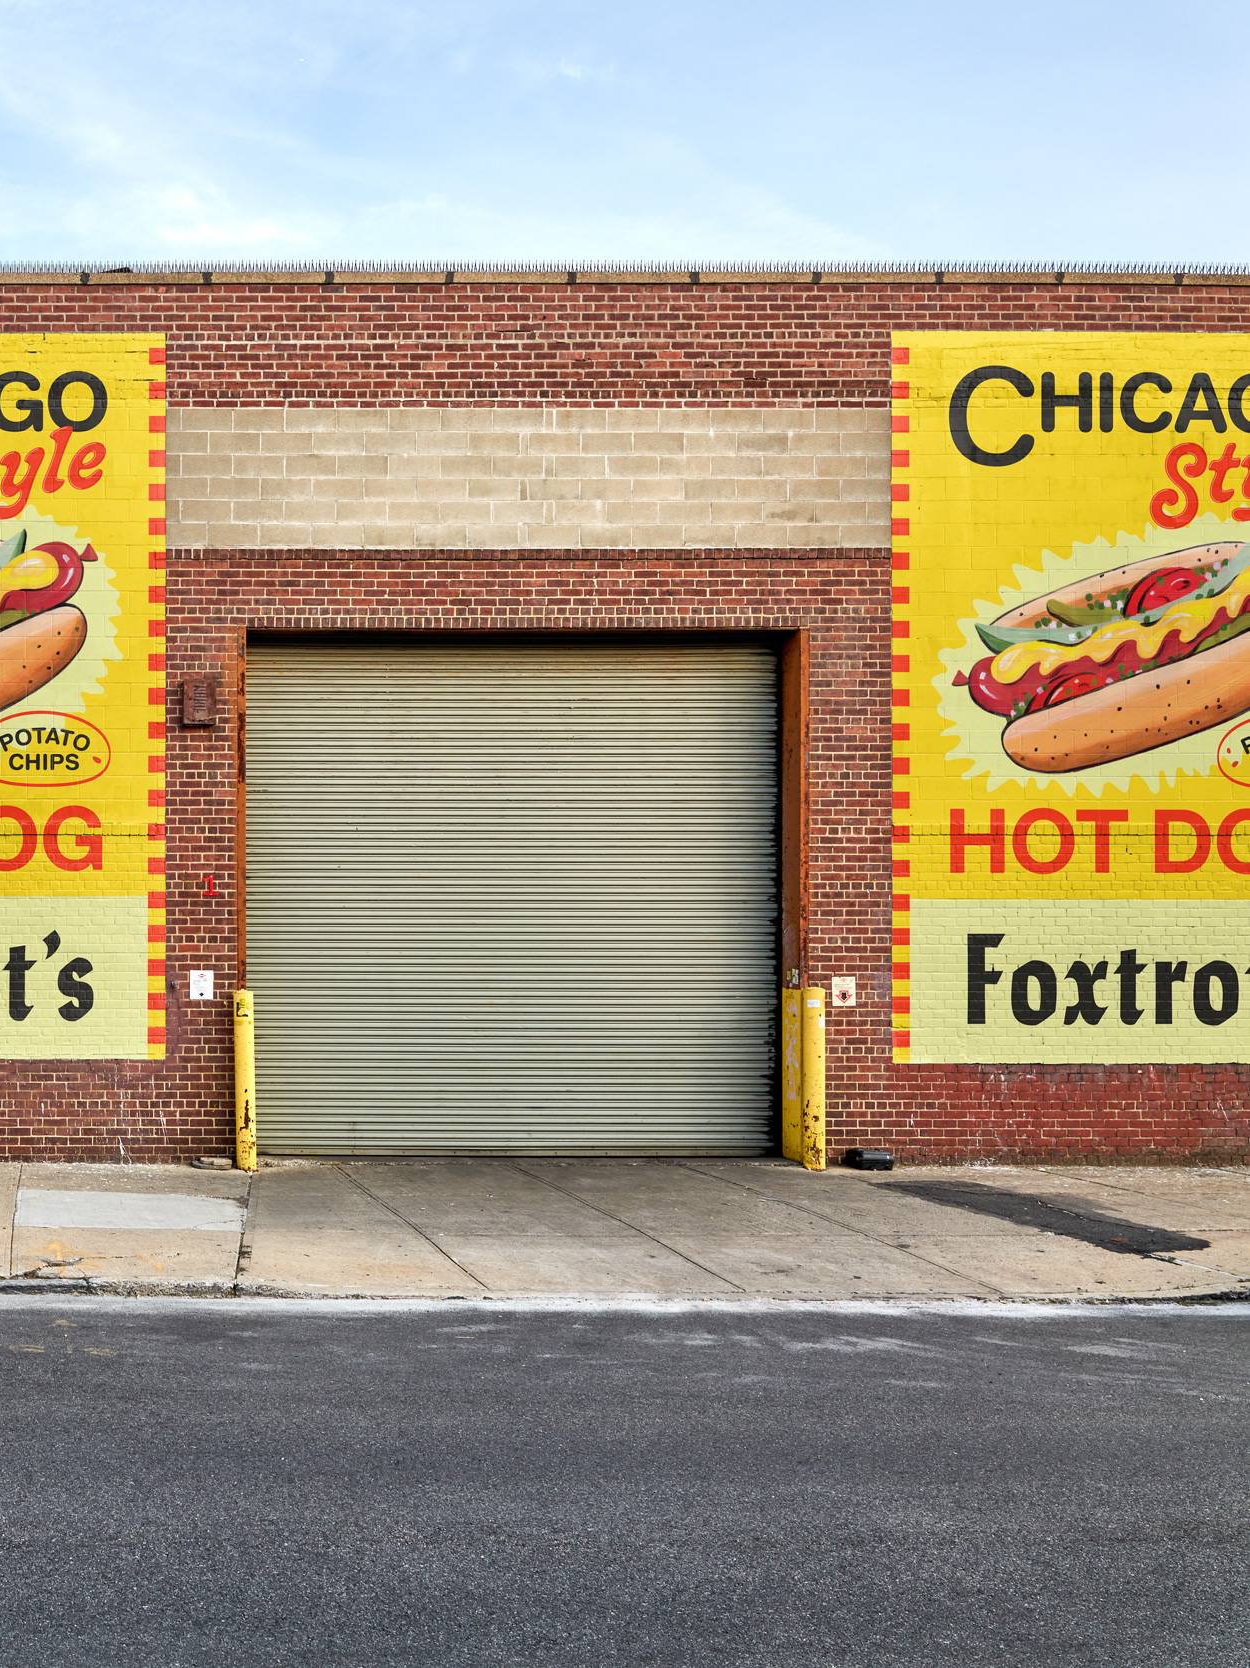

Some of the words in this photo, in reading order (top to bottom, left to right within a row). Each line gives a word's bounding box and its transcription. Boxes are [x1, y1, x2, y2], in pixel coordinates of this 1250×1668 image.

[1150, 442, 1250, 530] St
[8, 753, 80, 771] CHIPS
[949, 808, 1129, 875] HOT
[202, 875, 219, 896] 1
[966, 933, 1250, 1026] Foxtro
